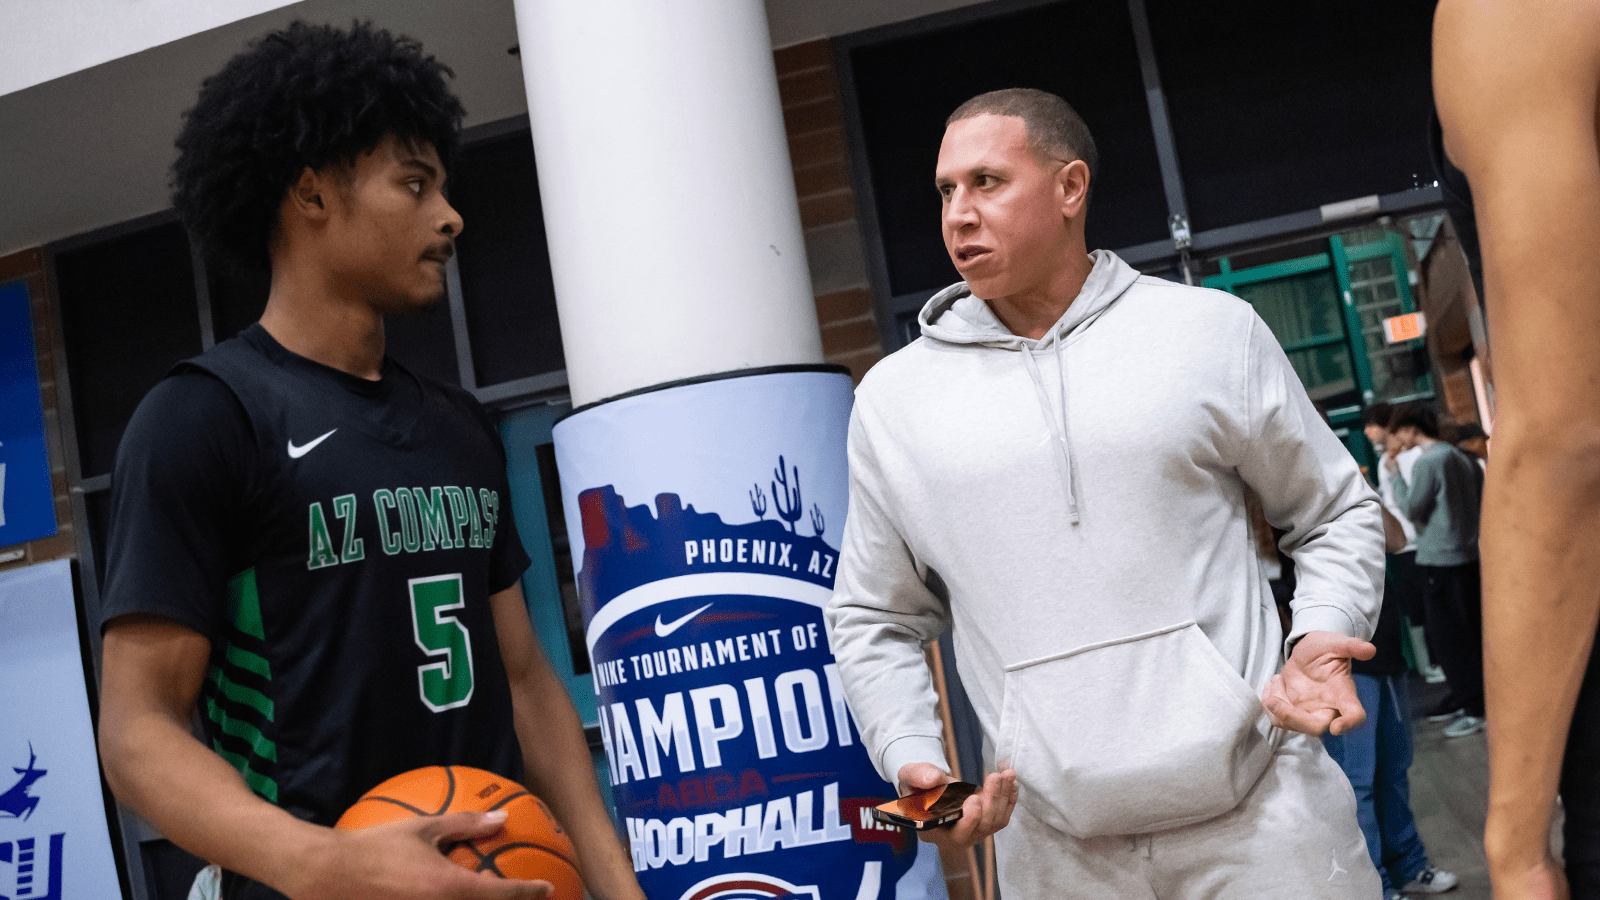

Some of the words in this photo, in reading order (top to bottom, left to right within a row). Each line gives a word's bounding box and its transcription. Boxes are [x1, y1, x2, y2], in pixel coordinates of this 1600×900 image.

[307, 493, 365, 570] AZ
[684, 538, 798, 572] PHOENIX,
[808, 550, 832, 578] AZ
[408, 572, 475, 713] 5
[630, 628, 781, 680] TOURNAMENT
[792, 623, 818, 651] OF
[625, 781, 852, 872] HOOPHALL
